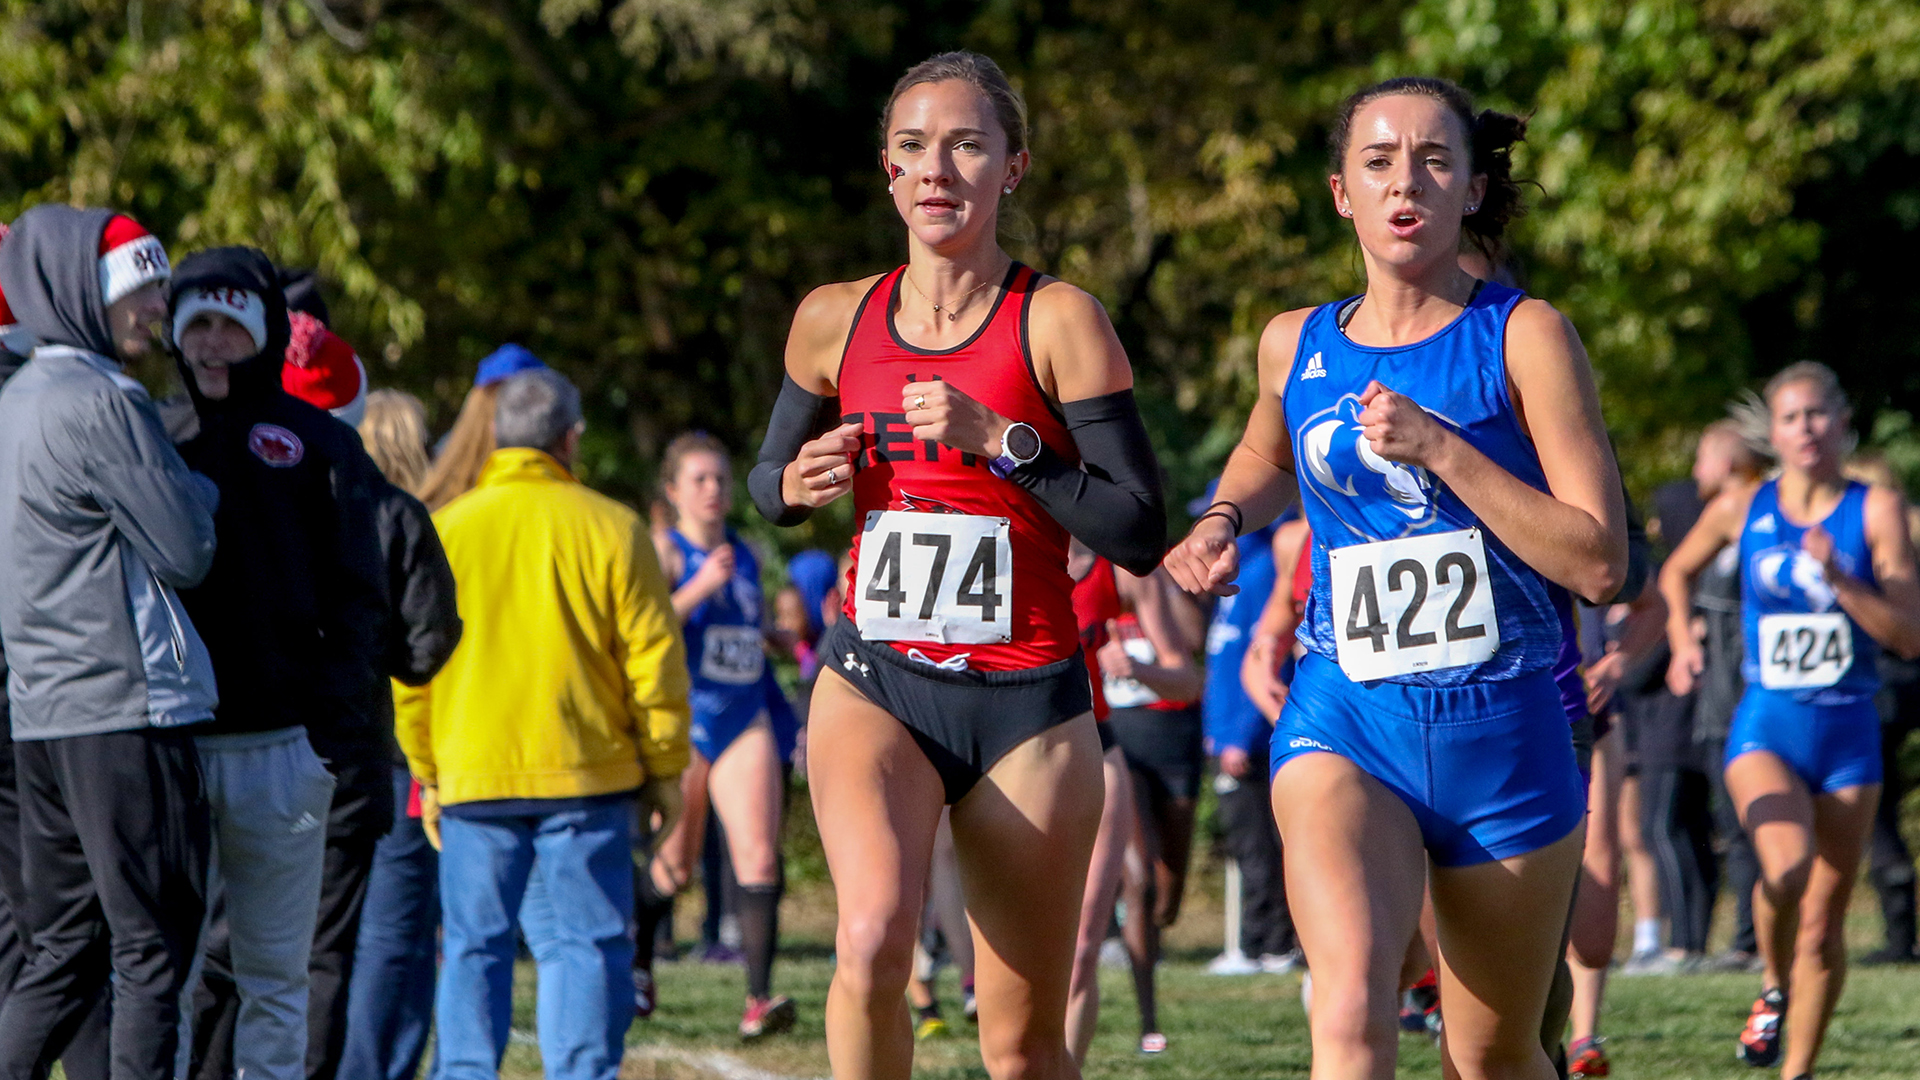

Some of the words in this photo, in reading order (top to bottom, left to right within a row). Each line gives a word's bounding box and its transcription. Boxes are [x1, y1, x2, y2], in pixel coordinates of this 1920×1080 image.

[865, 531, 1003, 623] 474
[1345, 551, 1487, 654] 422
[1772, 627, 1846, 672] 424
